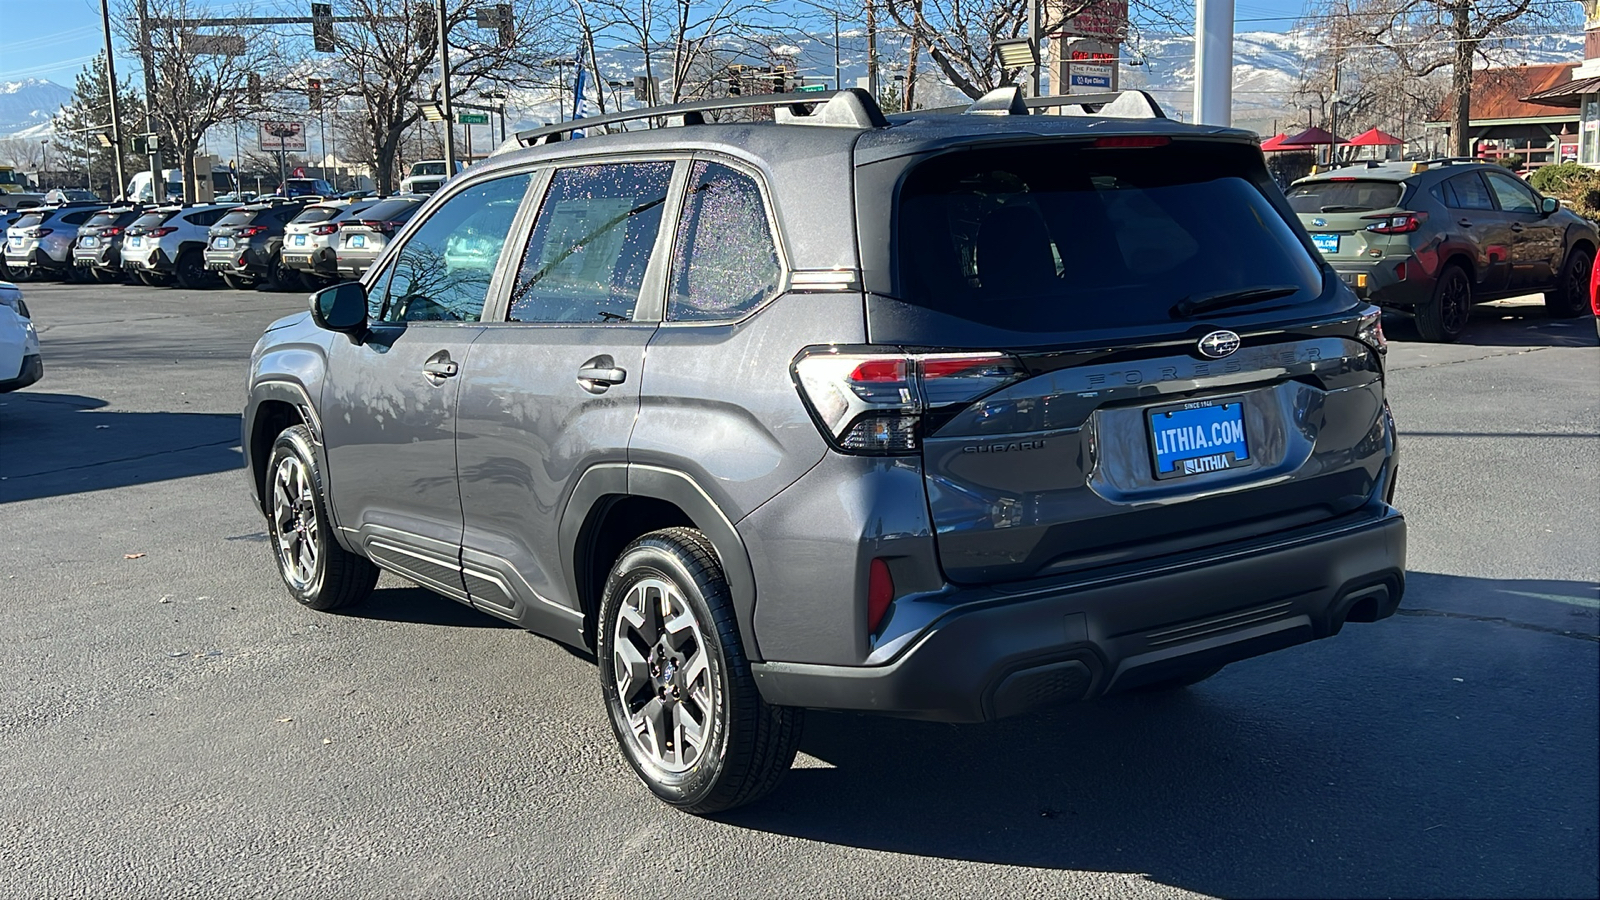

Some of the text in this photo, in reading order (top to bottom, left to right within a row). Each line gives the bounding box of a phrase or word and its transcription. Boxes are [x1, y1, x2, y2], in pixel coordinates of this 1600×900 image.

[1085, 347, 1322, 389] FORESTER
[1184, 400, 1213, 410] SINCE 1946
[1154, 419, 1245, 455] LITHIA.COM
[963, 440, 1046, 454] SUBARU
[1194, 454, 1230, 472] LITHIA
